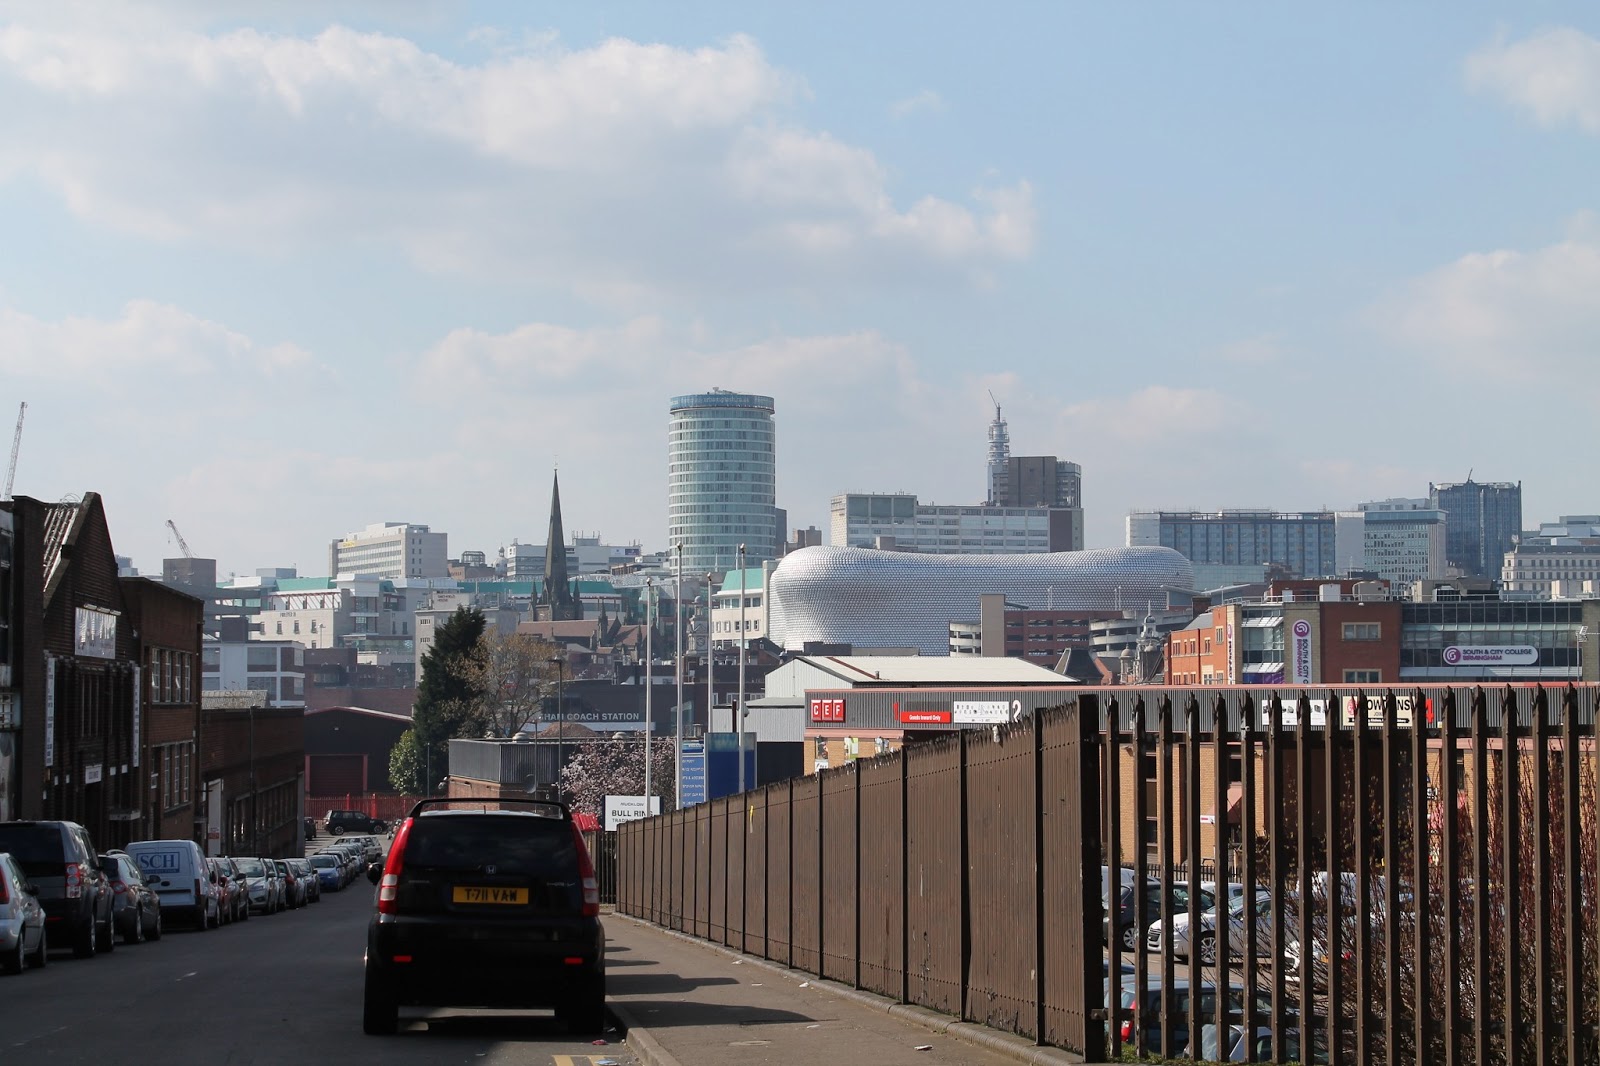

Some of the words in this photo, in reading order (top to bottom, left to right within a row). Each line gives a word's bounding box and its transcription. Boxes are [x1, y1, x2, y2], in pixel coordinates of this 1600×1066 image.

[602, 712, 639, 720] STATION
[611, 809, 631, 817] BULL
[140, 854, 175, 868] SCH
